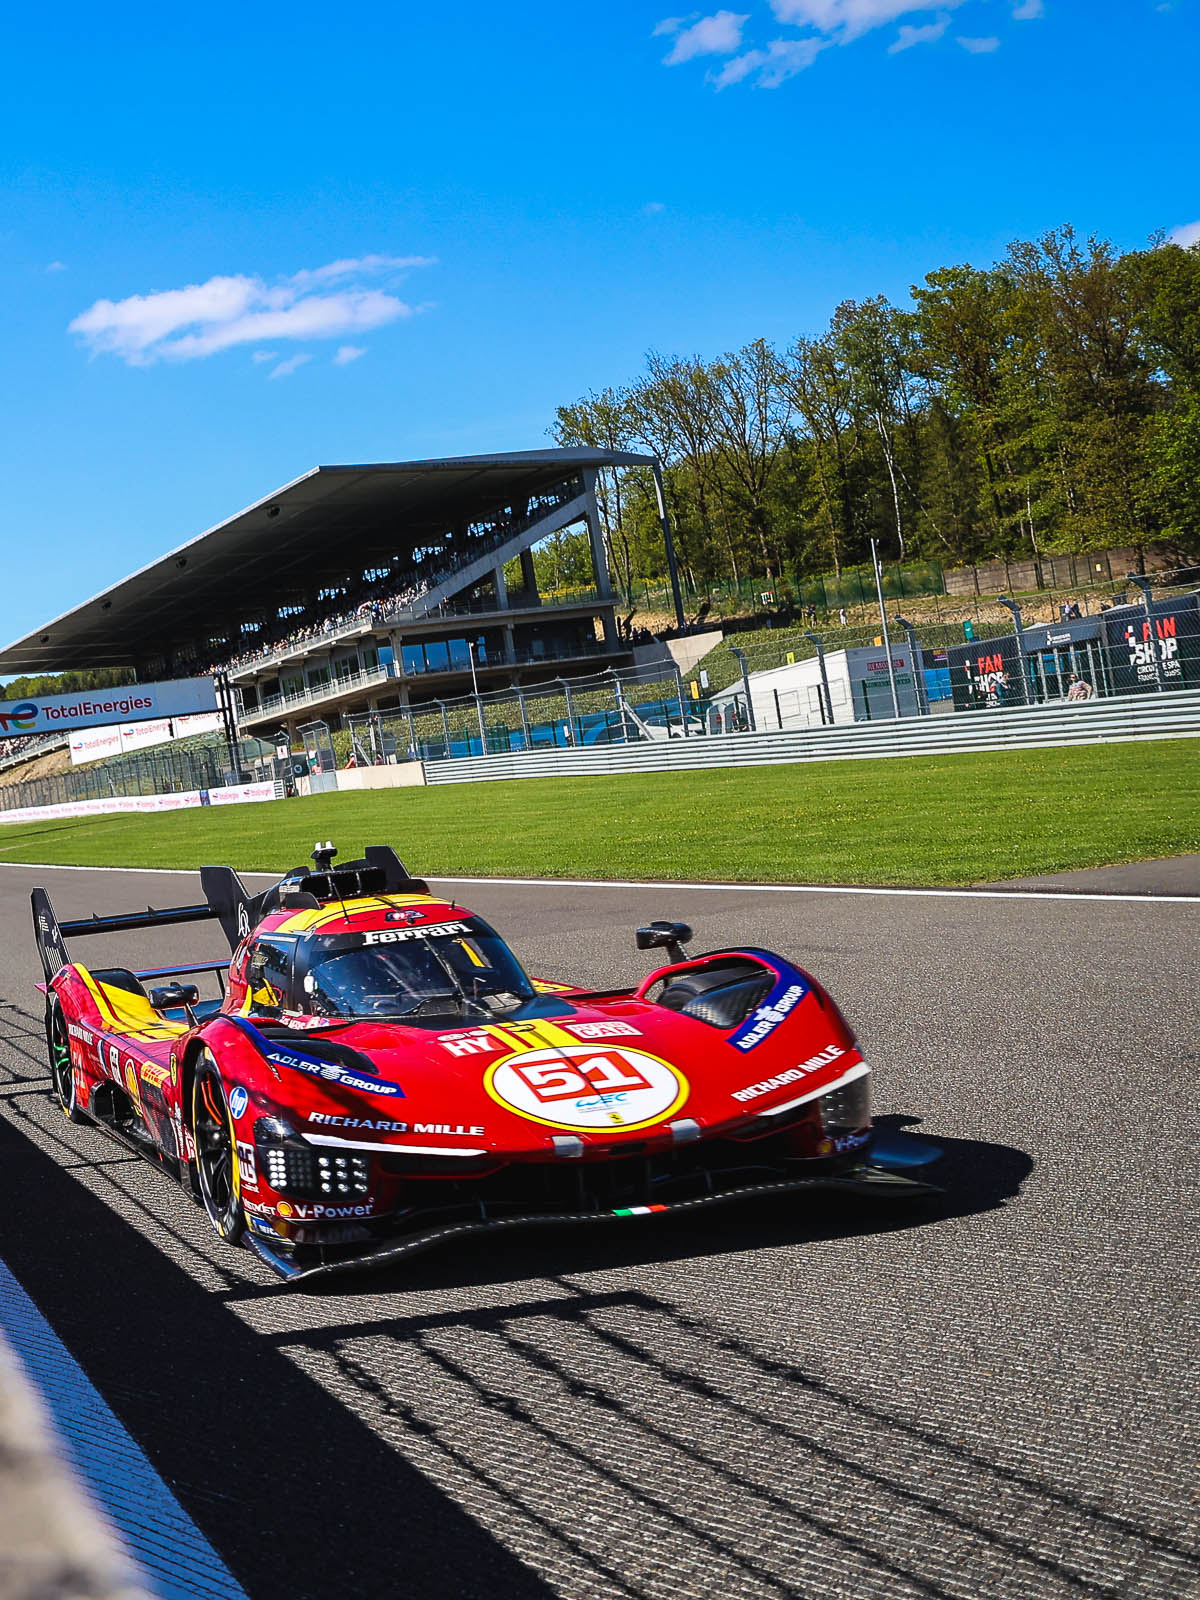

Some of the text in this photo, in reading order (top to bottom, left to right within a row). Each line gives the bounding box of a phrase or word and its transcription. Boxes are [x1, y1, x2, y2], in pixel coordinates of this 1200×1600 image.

[978, 653, 1004, 675] FAN
[42, 696, 152, 720] TotalEnergies
[362, 920, 473, 946] Ferrari
[736, 985, 805, 1049] ADLER GROUP
[444, 1036, 496, 1056] HY
[267, 1053, 397, 1095] ADLER GROUP
[518, 1056, 644, 1097] 51
[731, 1044, 846, 1102] RICHARD MILLE
[308, 1112, 485, 1136] RICHARD MILLE
[294, 1203, 373, 1218] V-Power
